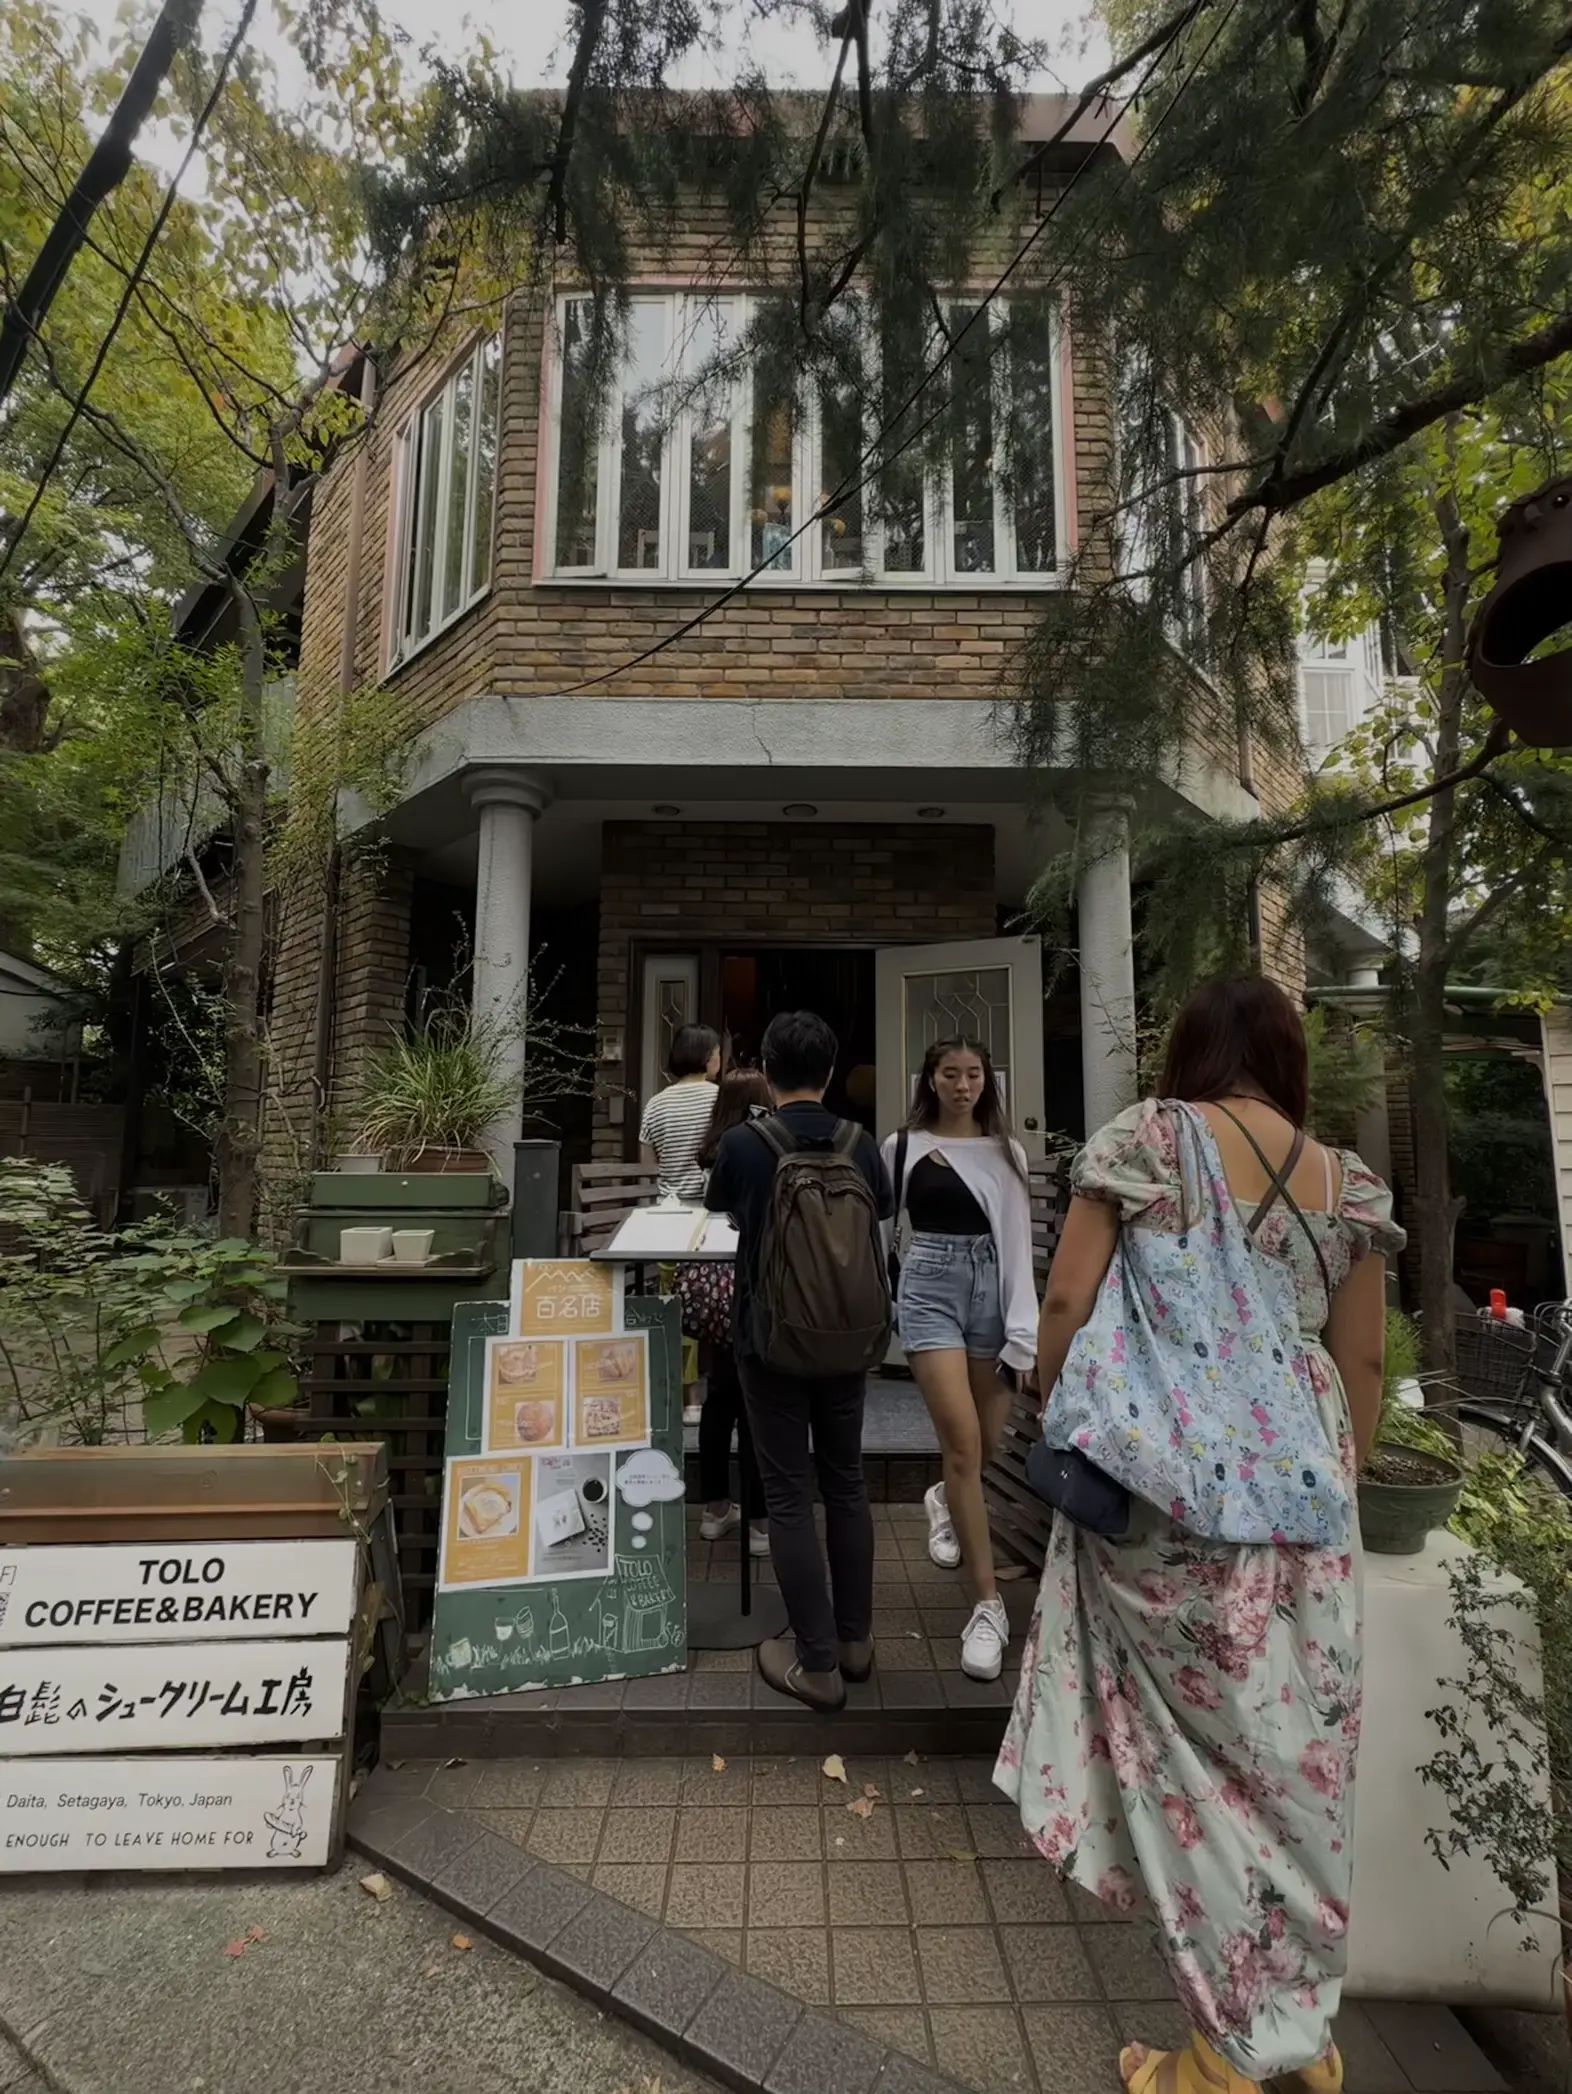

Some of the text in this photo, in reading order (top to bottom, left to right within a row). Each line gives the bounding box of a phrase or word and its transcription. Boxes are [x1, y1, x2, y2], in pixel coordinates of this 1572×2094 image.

[535, 1295, 604, 1319] 百名店
[138, 1557, 225, 1585] TOLO
[619, 1558, 653, 1578] TOLO
[25, 1592, 318, 1628] COFFEE&BAKERY
[6, 1793, 48, 1809] Daita,
[57, 1793, 128, 1810] Setagaya,
[189, 1792, 233, 1810] Japan
[5, 1831, 254, 1848] ENOUGH TO LEAVE HOME FOR
